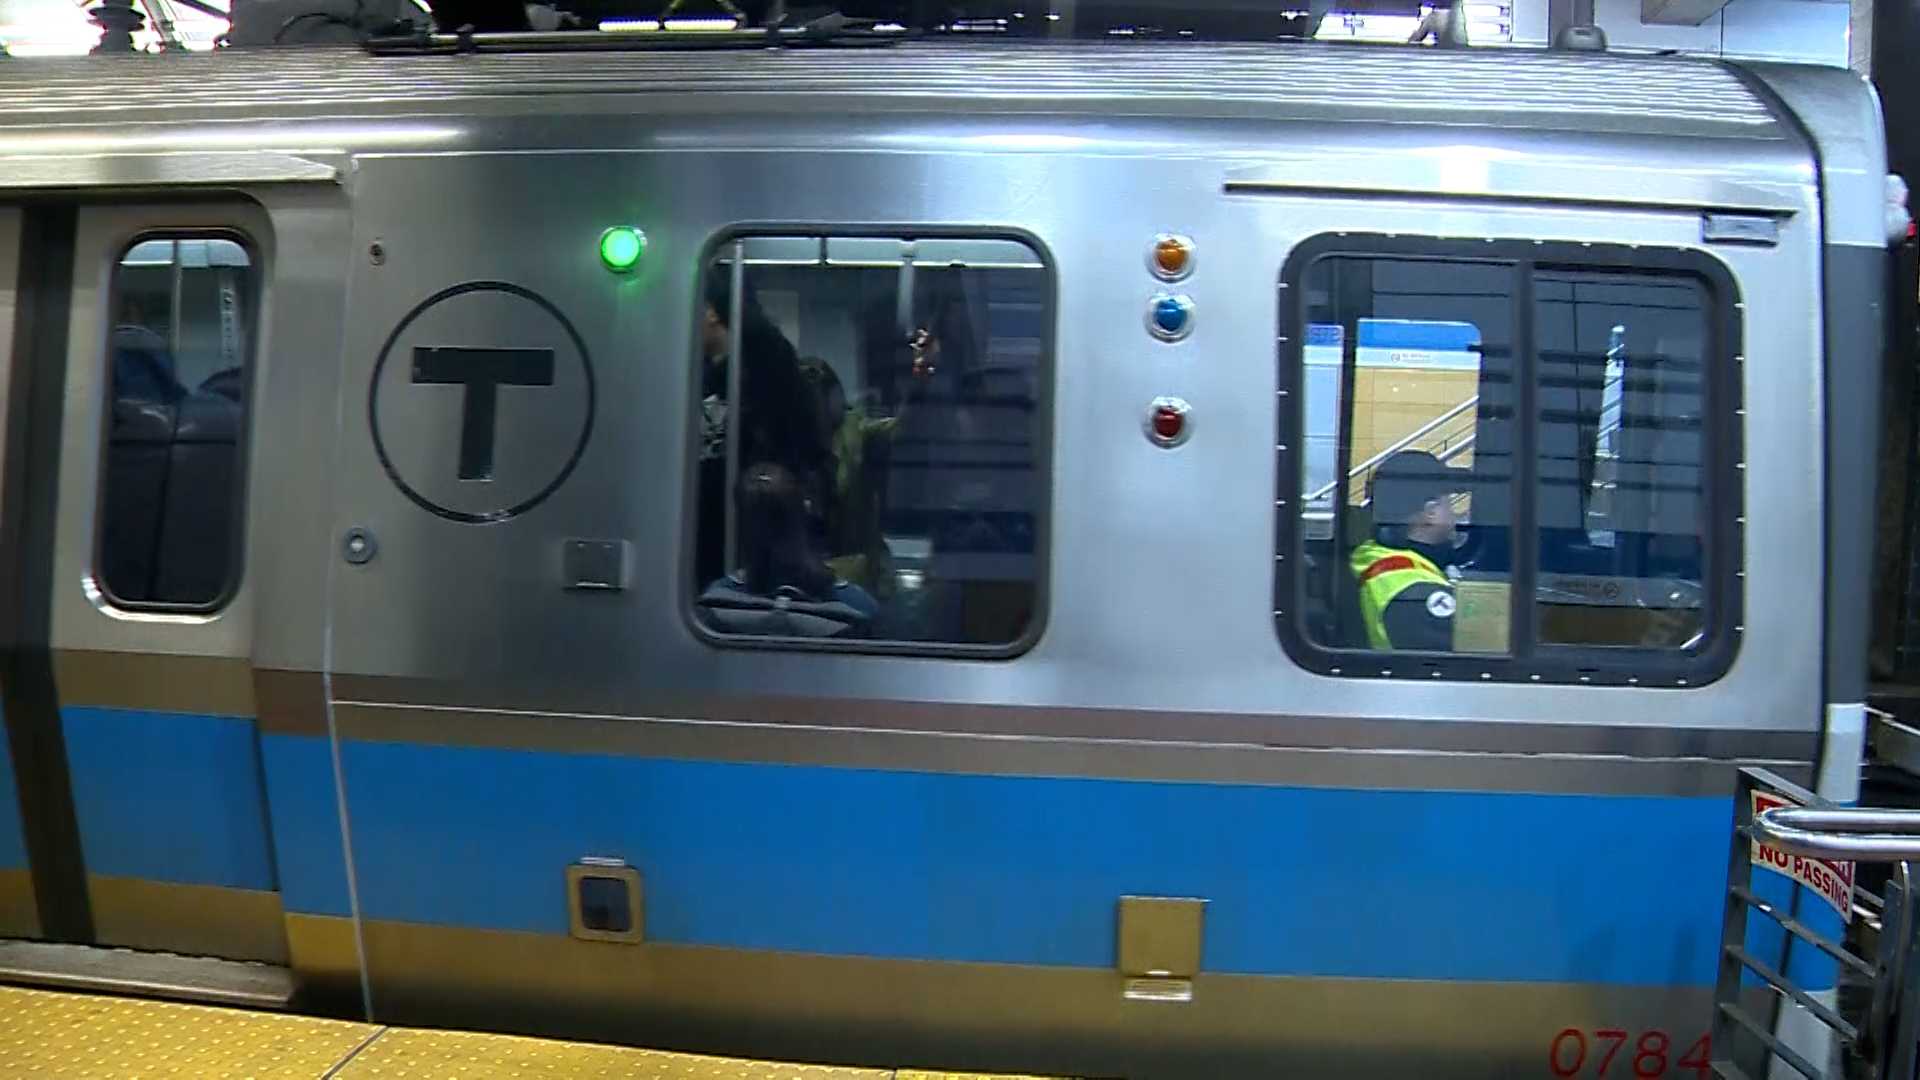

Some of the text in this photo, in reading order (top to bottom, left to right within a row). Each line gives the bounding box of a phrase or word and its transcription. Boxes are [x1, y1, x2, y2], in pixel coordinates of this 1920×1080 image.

[412, 347, 554, 480] T
[1760, 845, 1789, 868] NO
[1794, 856, 1848, 912] PASSING
[1550, 1028, 1713, 1080] 0784
